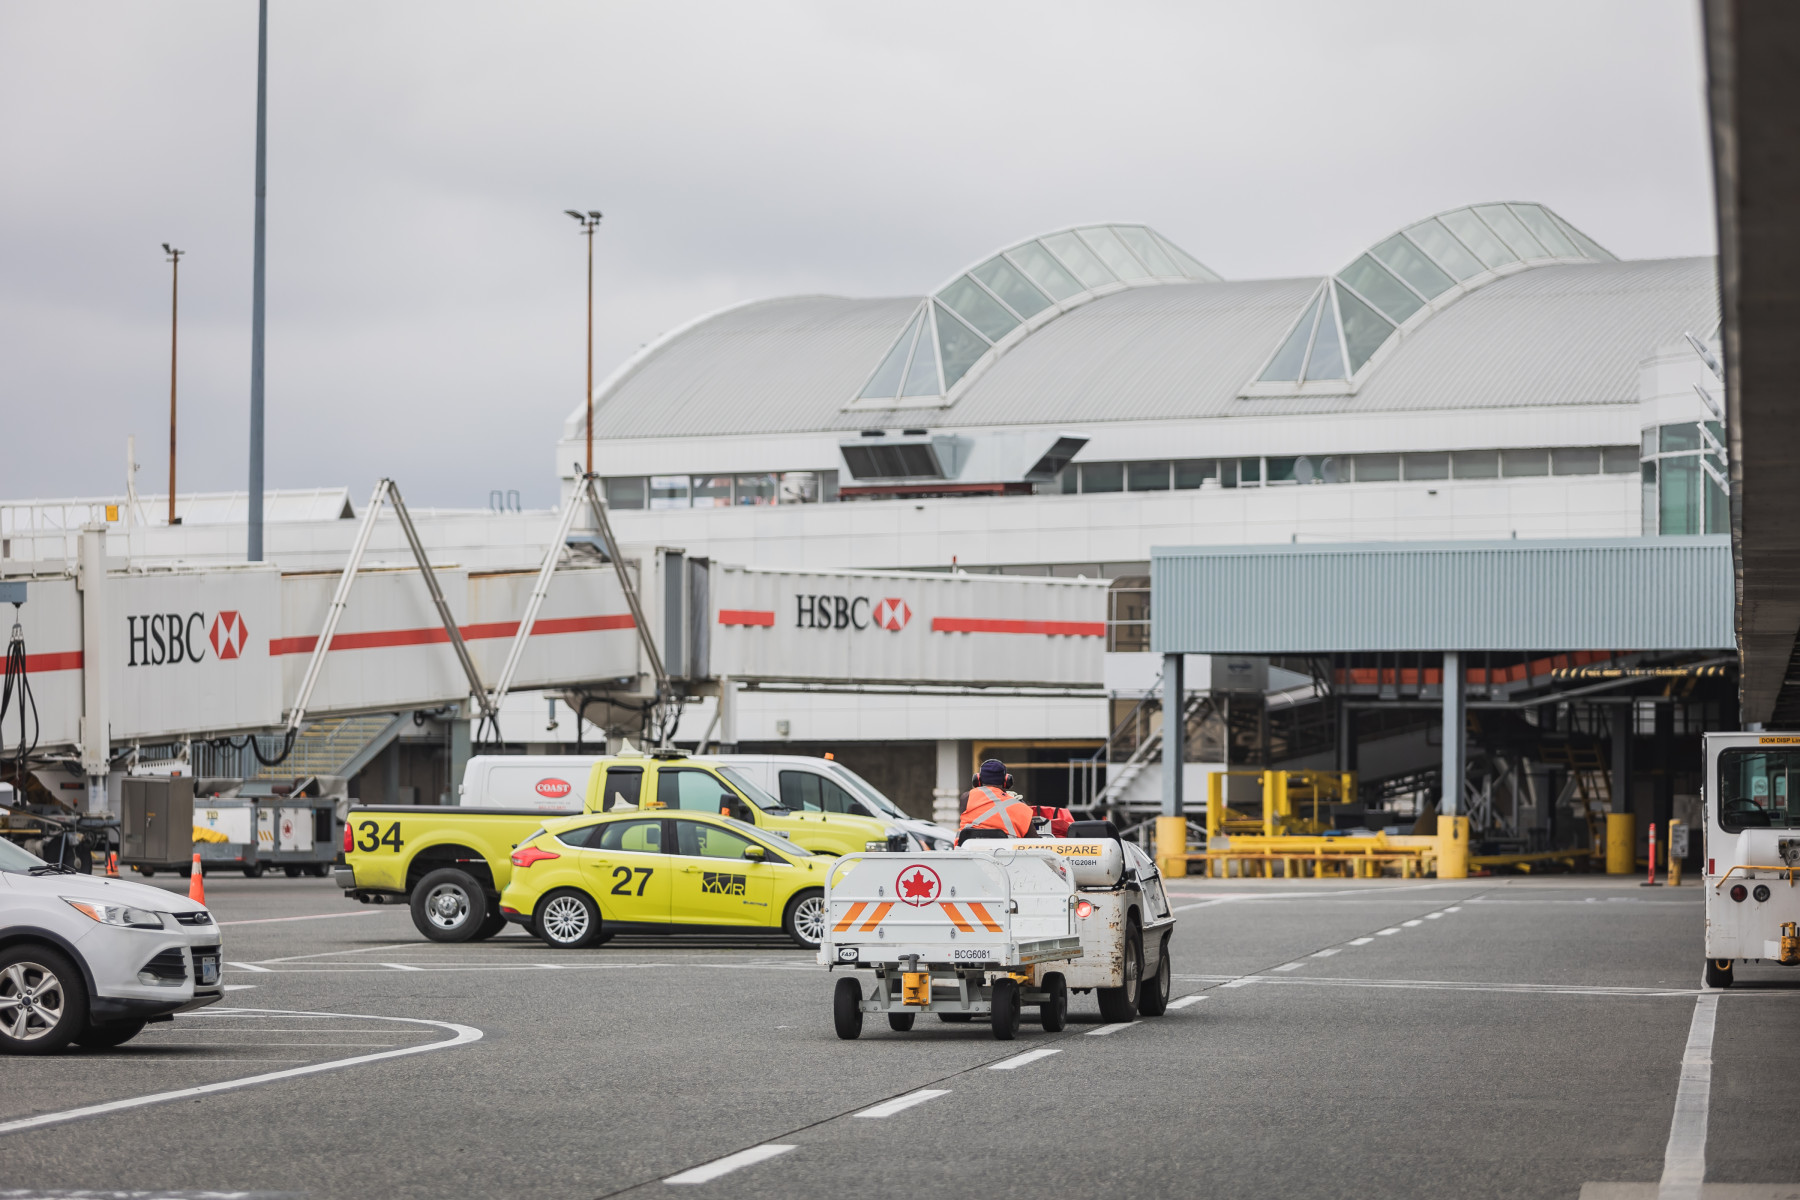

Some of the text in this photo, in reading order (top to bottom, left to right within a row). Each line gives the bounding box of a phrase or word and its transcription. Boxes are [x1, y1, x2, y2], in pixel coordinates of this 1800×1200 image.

[796, 594, 870, 630] HSBC
[127, 612, 205, 666] HSBC
[537, 784, 569, 792] COAST
[357, 820, 404, 853] 34
[1056, 845, 1098, 855] SPARE
[611, 866, 654, 896] 27
[702, 879, 746, 896] YVR
[954, 949, 990, 959] BCG6081
